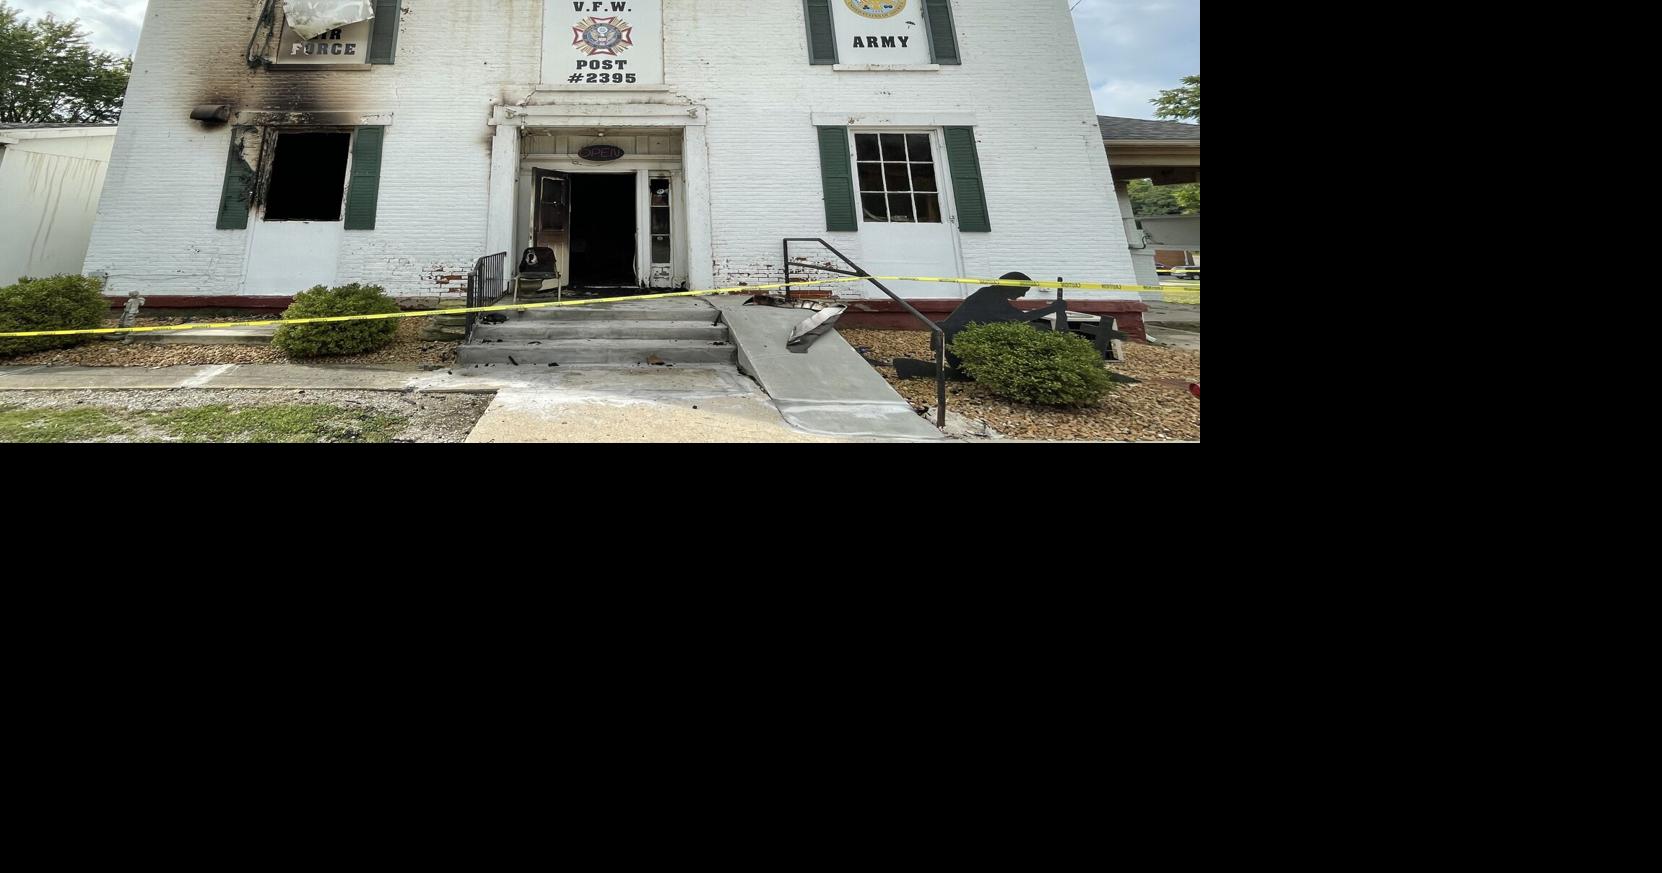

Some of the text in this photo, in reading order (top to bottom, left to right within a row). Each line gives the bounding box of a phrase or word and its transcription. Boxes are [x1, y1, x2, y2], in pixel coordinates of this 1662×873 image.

[573, 1, 632, 12] V.F.W.
[853, 36, 909, 48] ARMY
[576, 59, 628, 70] POST
[567, 72, 637, 83] #2395
[580, 147, 621, 158] OPEN
